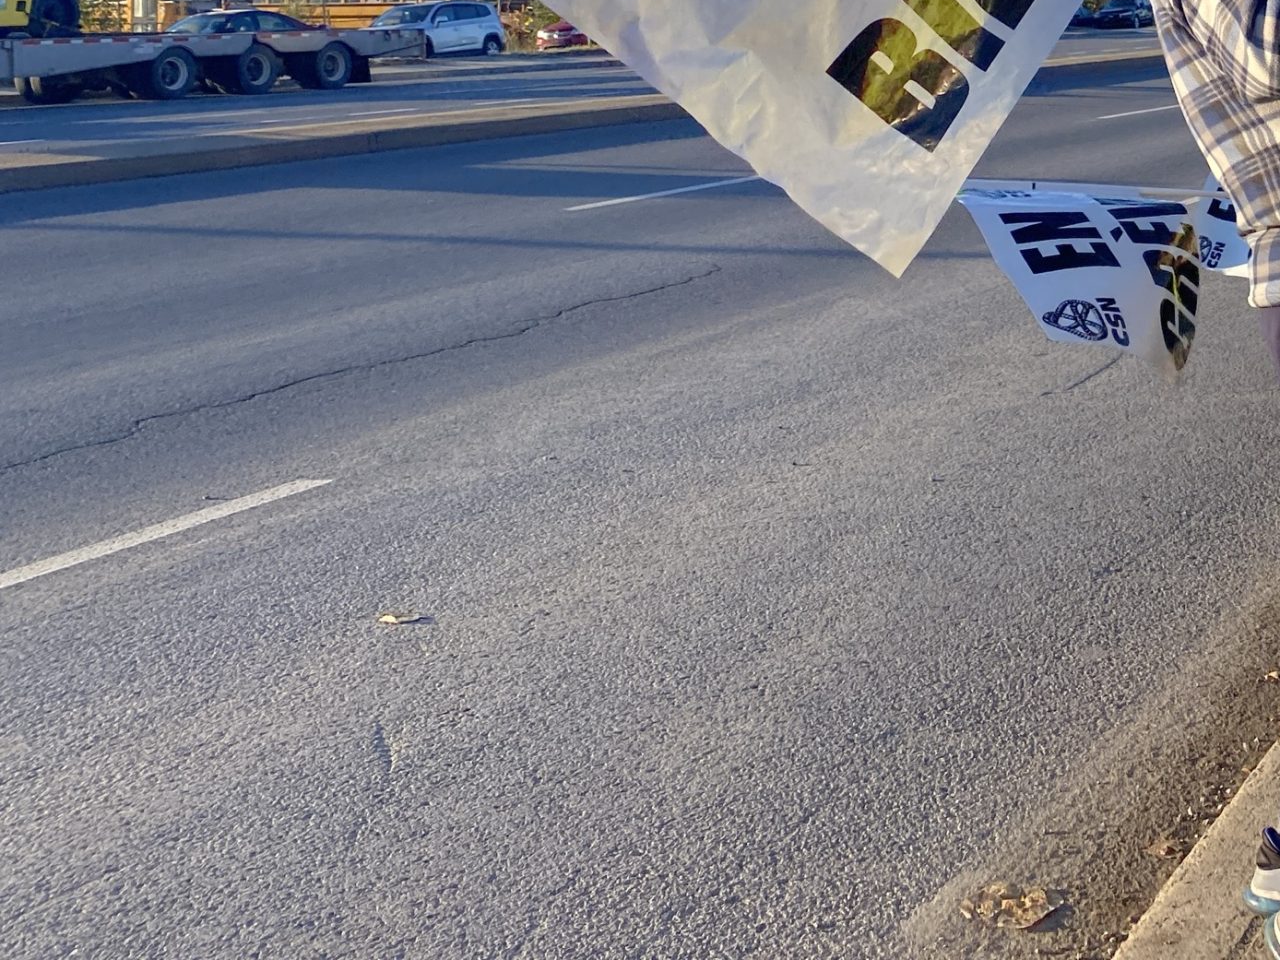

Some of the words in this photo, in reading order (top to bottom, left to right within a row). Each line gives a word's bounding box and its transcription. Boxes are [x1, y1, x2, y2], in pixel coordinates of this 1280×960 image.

[998, 212, 1121, 274] EN
[1207, 242, 1226, 269] CSN
[1095, 297, 1130, 347] CSN
